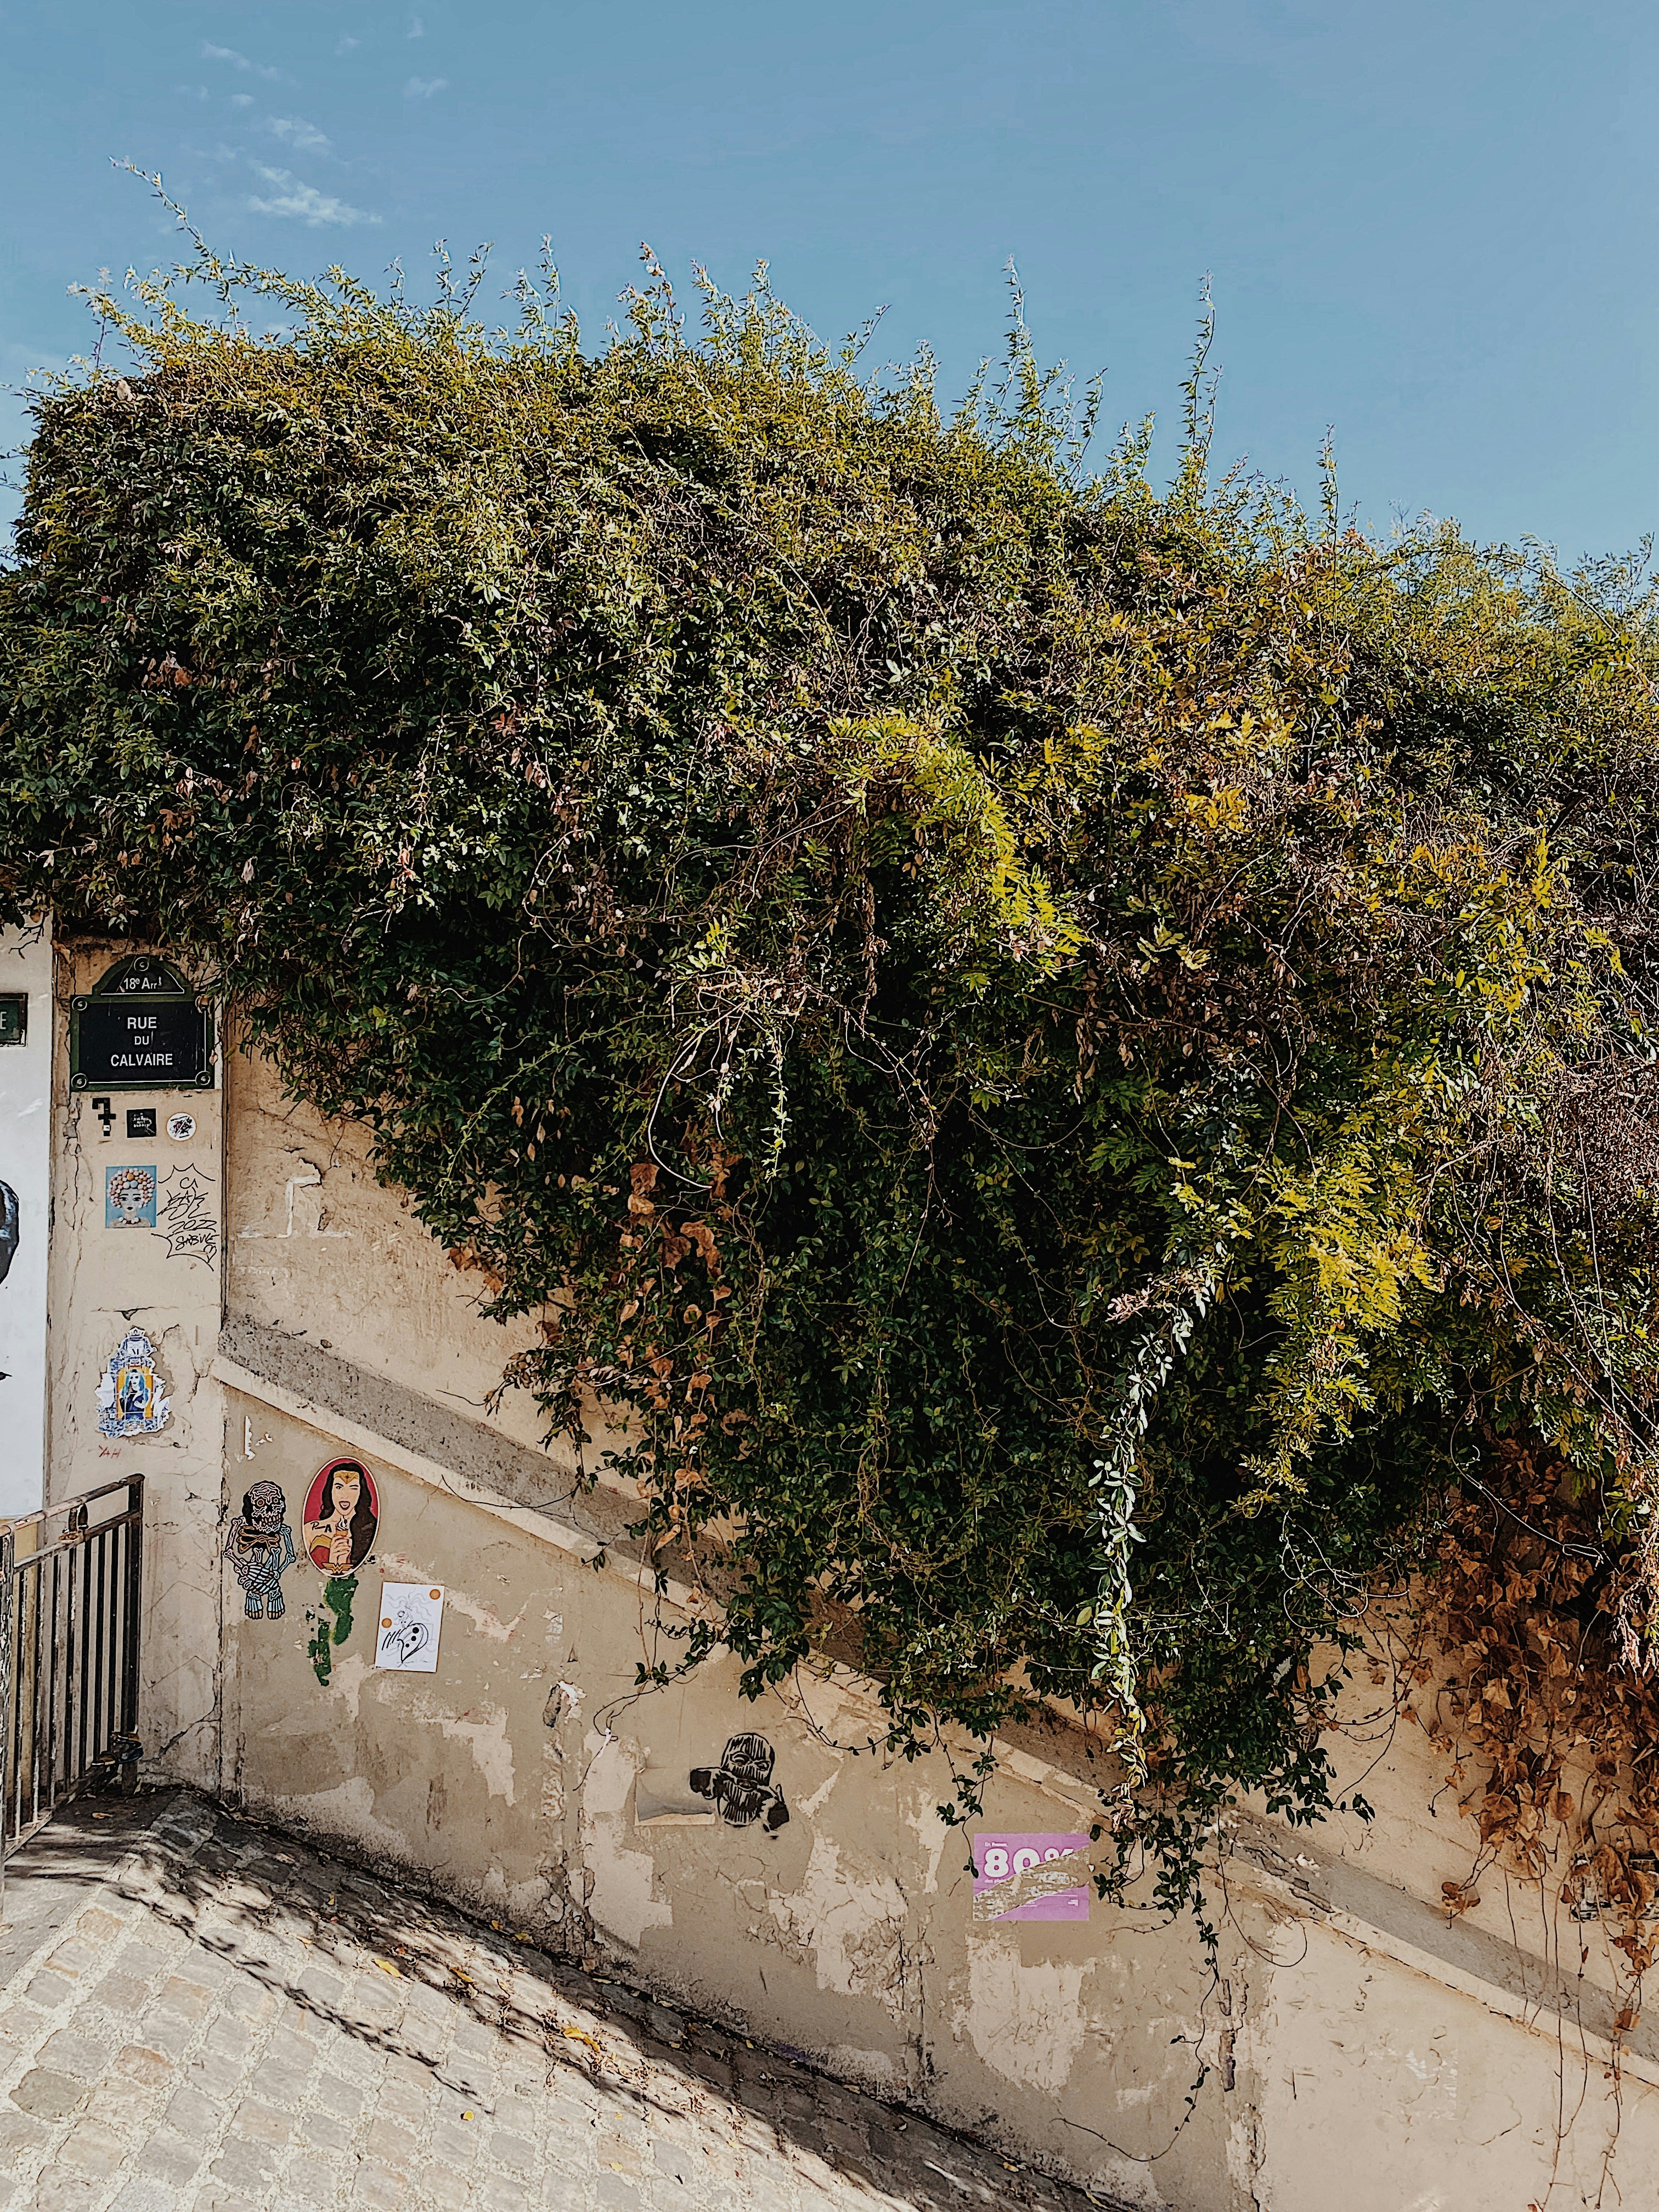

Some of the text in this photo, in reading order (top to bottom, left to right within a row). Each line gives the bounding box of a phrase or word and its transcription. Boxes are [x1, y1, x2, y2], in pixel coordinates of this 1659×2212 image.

[127, 1017, 157, 1029] RUE
[134, 1036, 149, 1045] DU
[111, 1053, 173, 1066] CALVAIRE
